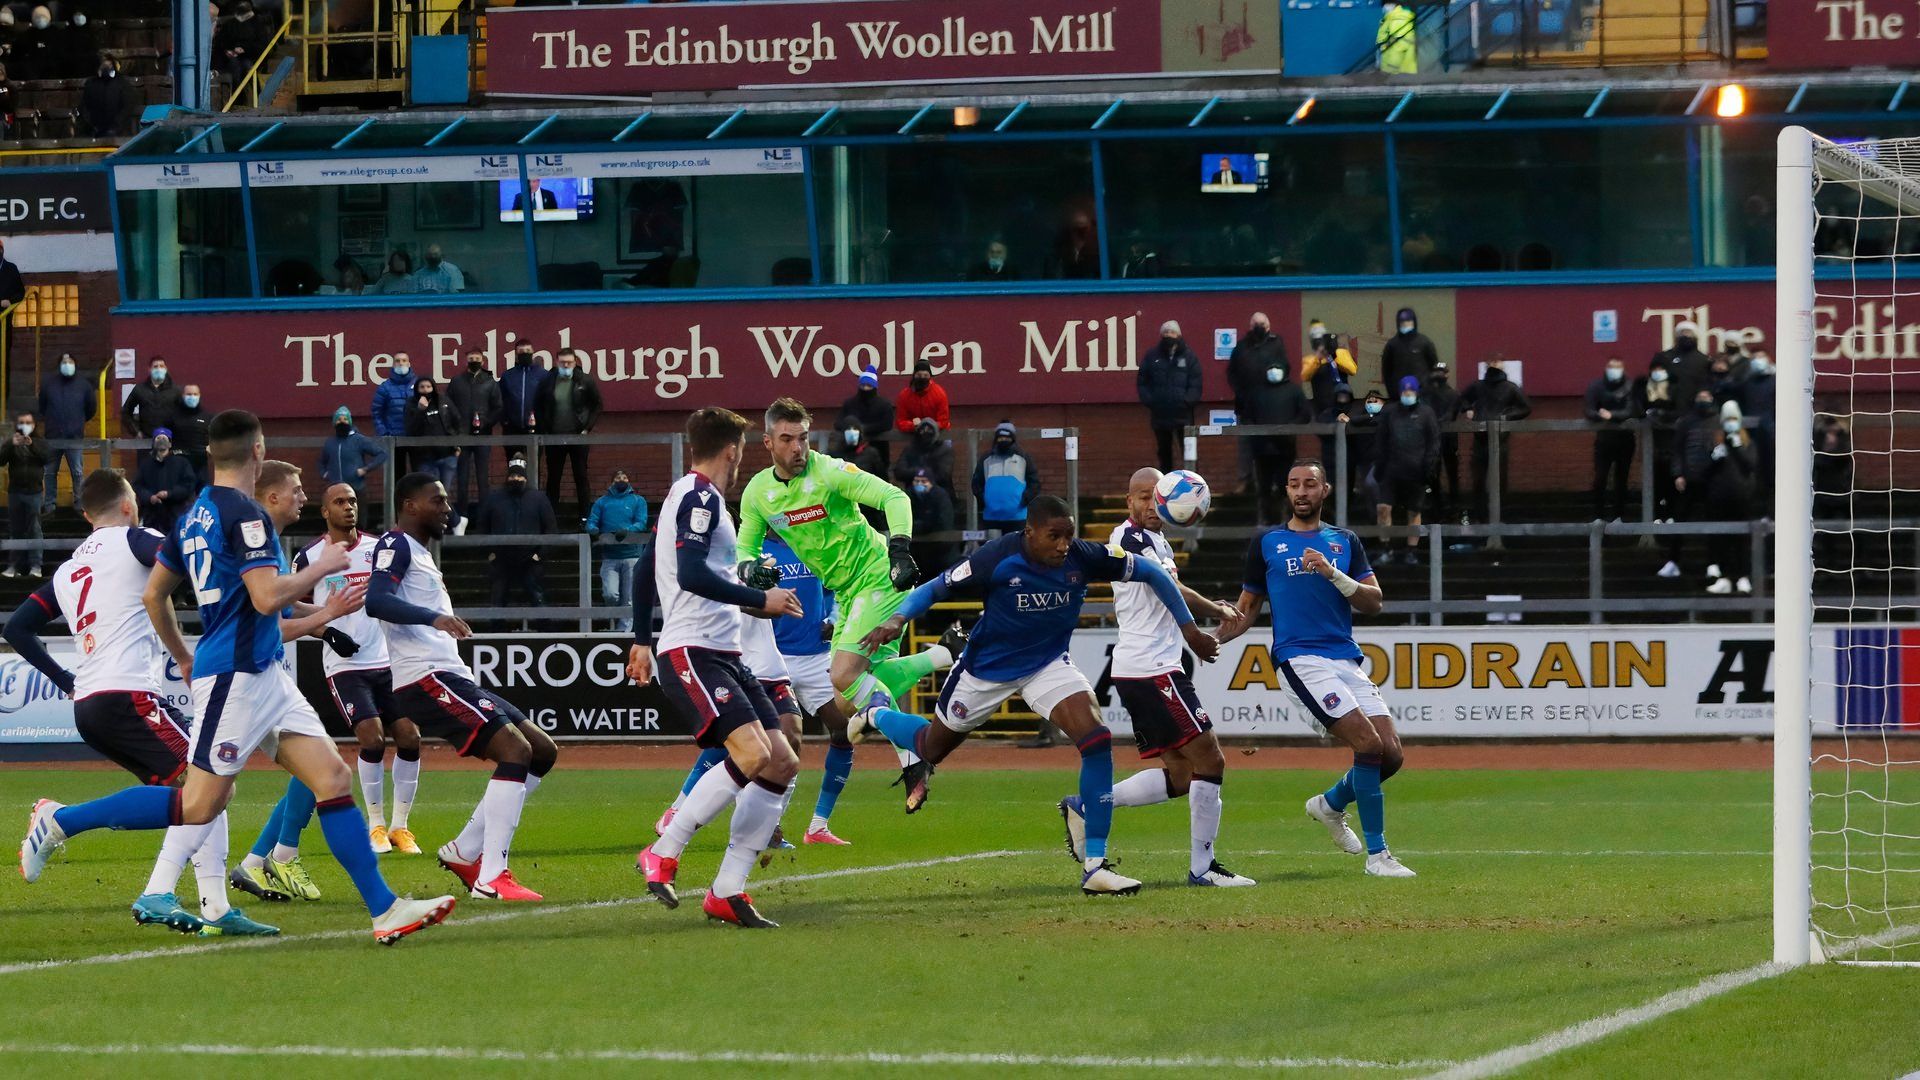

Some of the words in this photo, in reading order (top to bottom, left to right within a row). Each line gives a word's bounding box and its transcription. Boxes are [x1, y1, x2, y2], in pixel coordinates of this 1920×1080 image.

[1815, 0, 1905, 41] The
[532, 30, 612, 69] The
[624, 22, 837, 75] Edinburgh
[846, 17, 1016, 60] Woollen
[1029, 11, 1116, 54] Mill
[480, 156, 509, 168] NLE
[535, 155, 562, 166] NLE
[764, 148, 792, 160] NLE
[163, 165, 190, 176] NLE
[257, 162, 284, 174] NLE
[320, 165, 430, 178] www.nlegroup.co.uk
[600, 157, 711, 170] www.nlegroup.co.uk
[39, 197, 86, 220] F.C.
[284, 332, 393, 387] The
[747, 320, 987, 378] Woollen
[1019, 315, 1140, 373] Mill
[789, 508, 824, 521] bargains
[70, 565, 96, 634] 2
[1016, 591, 1070, 608] EWM
[1227, 640, 1667, 691] AOIDRAIN
[569, 708, 660, 731] WATER
[1222, 705, 1289, 723] DRAIN
[1454, 704, 1534, 722] SEWER
[1543, 702, 1661, 721] SERVICES
